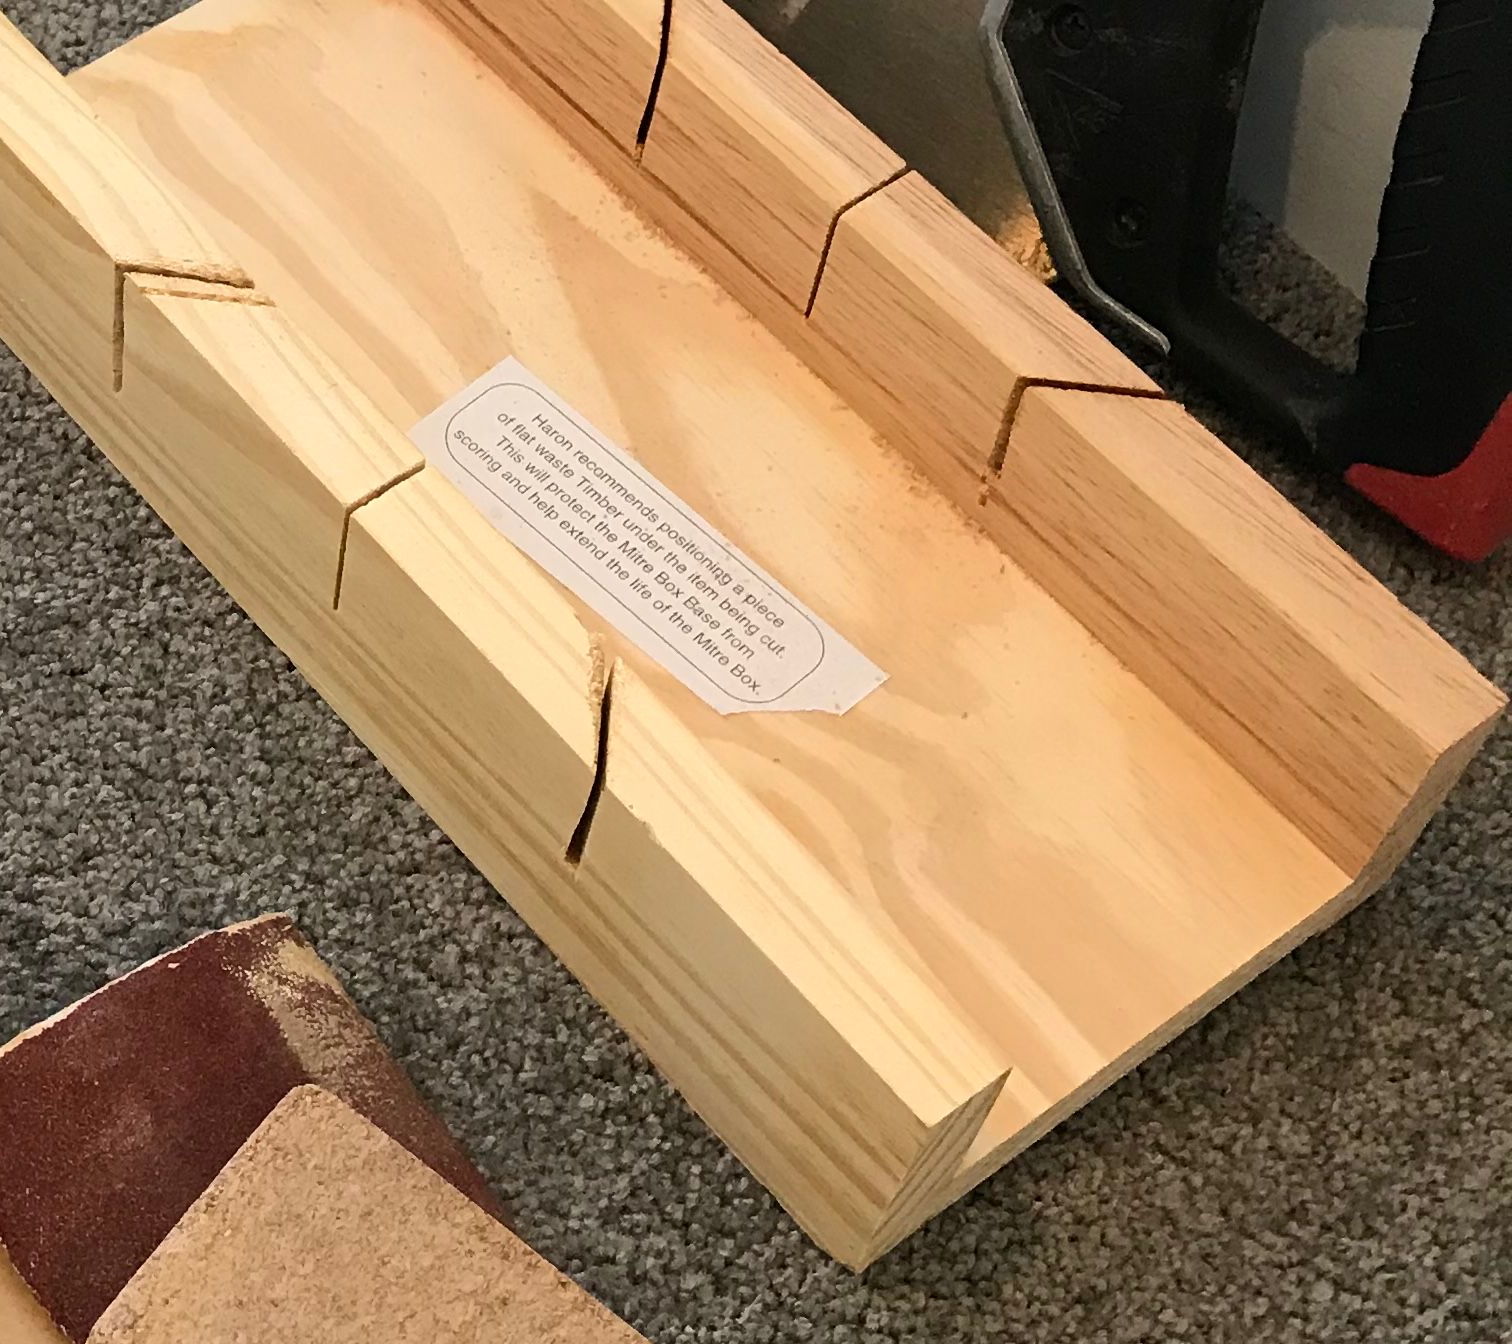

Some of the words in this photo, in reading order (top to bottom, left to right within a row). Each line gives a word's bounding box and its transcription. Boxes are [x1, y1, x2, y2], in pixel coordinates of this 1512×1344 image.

[453, 429, 503, 473] scoring
[501, 471, 532, 494] and
[527, 492, 560, 520] help
[559, 520, 609, 560] extend
[605, 558, 630, 580] the
[629, 577, 653, 599] life
[652, 599, 673, 614] of
[668, 611, 693, 634] the
[692, 632, 730, 666] Mitre
[729, 663, 762, 695] Box.
[496, 435, 525, 464] This
[524, 462, 551, 483] will
[543, 482, 597, 523] protect
[594, 520, 618, 543] the
[617, 540, 655, 574] Mitre
[654, 571, 685, 599] Box
[683, 595, 721, 630] Base
[720, 627, 756, 660] from
[497, 413, 517, 427] of
[511, 424, 537, 446] flat
[534, 443, 575, 479] waste
[576, 476, 625, 519] Timber
[622, 518, 665, 553] under
[663, 551, 688, 574] the
[687, 572, 720, 601] item
[719, 598, 761, 636] being
[759, 634, 787, 659] cut.
[531, 413, 574, 451] Haron
[573, 450, 660, 523] recommends
[656, 522, 733, 586] positioning
[732, 584, 746, 595] a
[742, 592, 785, 628] piece
